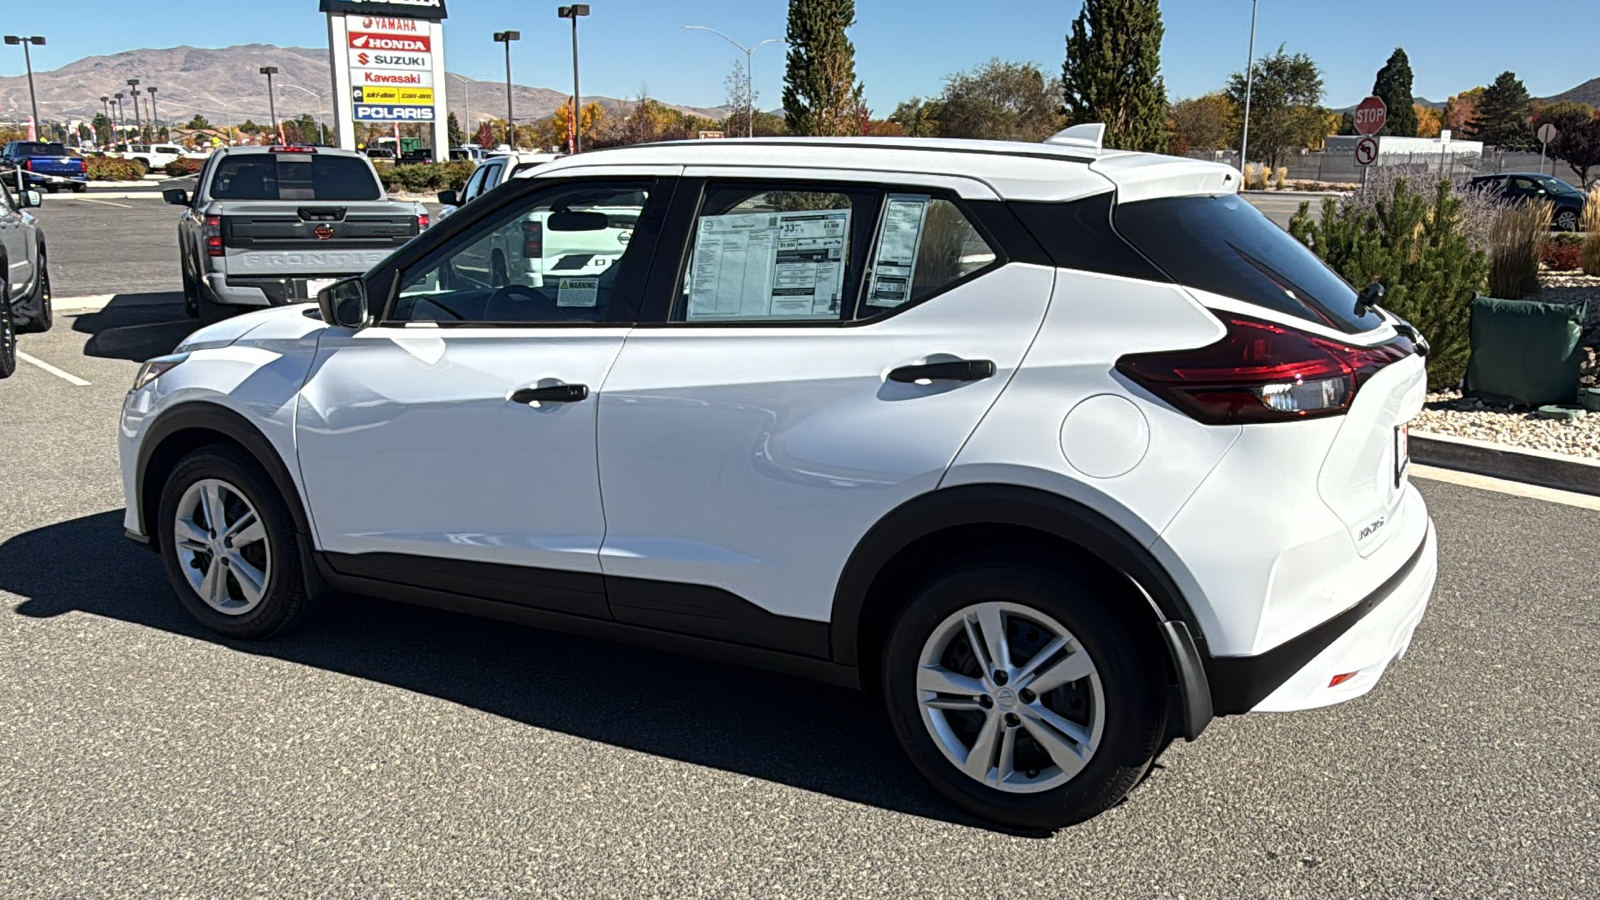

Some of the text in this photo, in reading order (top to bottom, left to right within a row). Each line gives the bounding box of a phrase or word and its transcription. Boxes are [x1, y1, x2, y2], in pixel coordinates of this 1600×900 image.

[374, 18, 417, 32] YAMAHA
[368, 38, 427, 50] HONDA
[374, 55, 425, 66] SUZUKI
[364, 72, 421, 84] Kawasaki
[357, 107, 433, 119] POLARIS
[1356, 108, 1384, 124] STOP
[784, 224, 795, 232] 33
[244, 253, 382, 266] FRONTIE
